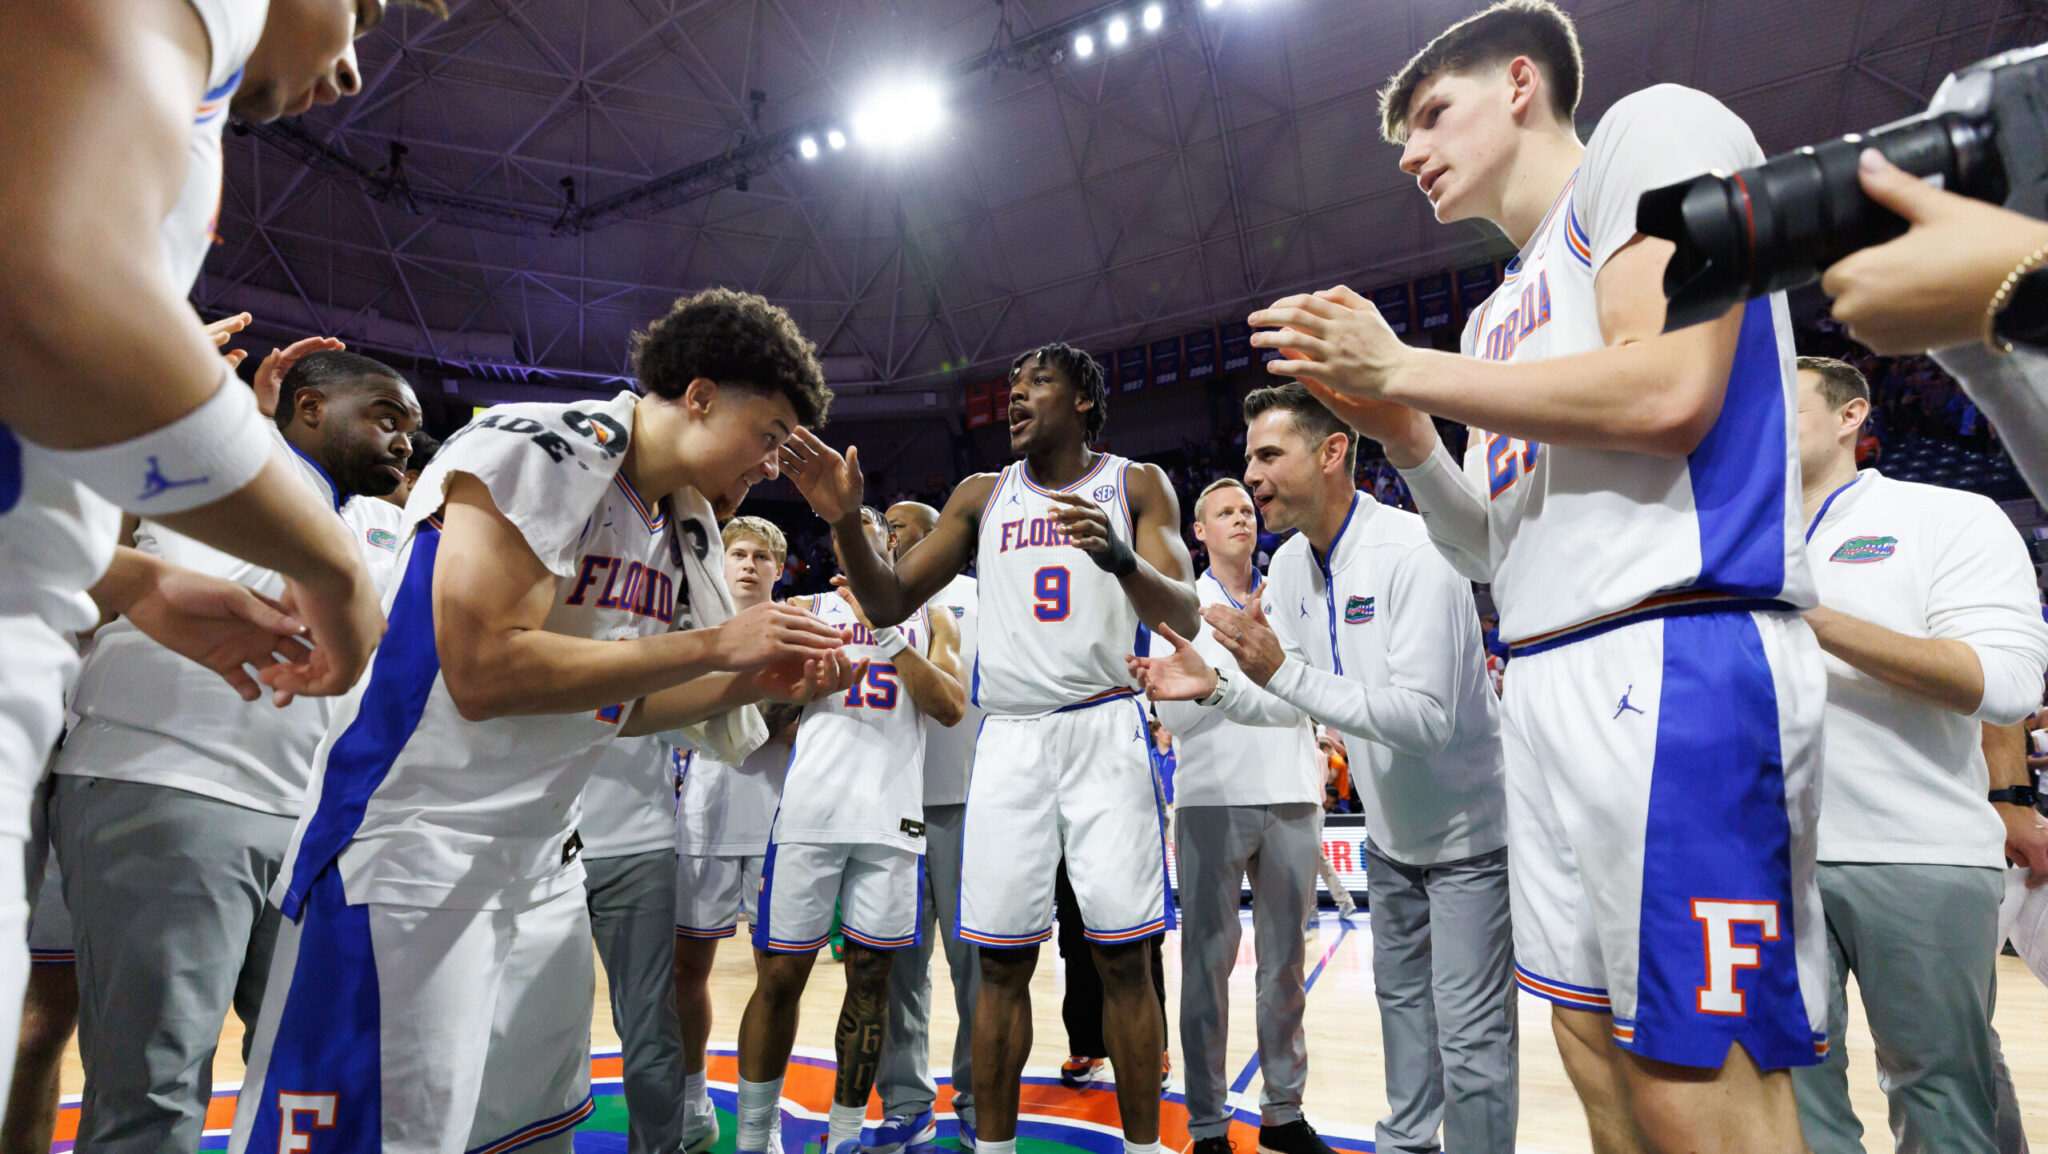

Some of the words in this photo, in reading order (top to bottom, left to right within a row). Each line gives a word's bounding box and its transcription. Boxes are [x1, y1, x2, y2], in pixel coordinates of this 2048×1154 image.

[1485, 269, 1551, 361] ORDA
[1094, 486, 1114, 501] SEC
[1000, 518, 1072, 553] FLOR
[565, 554, 673, 624] FLOID
[1034, 566, 1071, 622] 9
[844, 661, 898, 711] 15
[1689, 897, 1781, 1017] F
[276, 1089, 340, 1154] F
